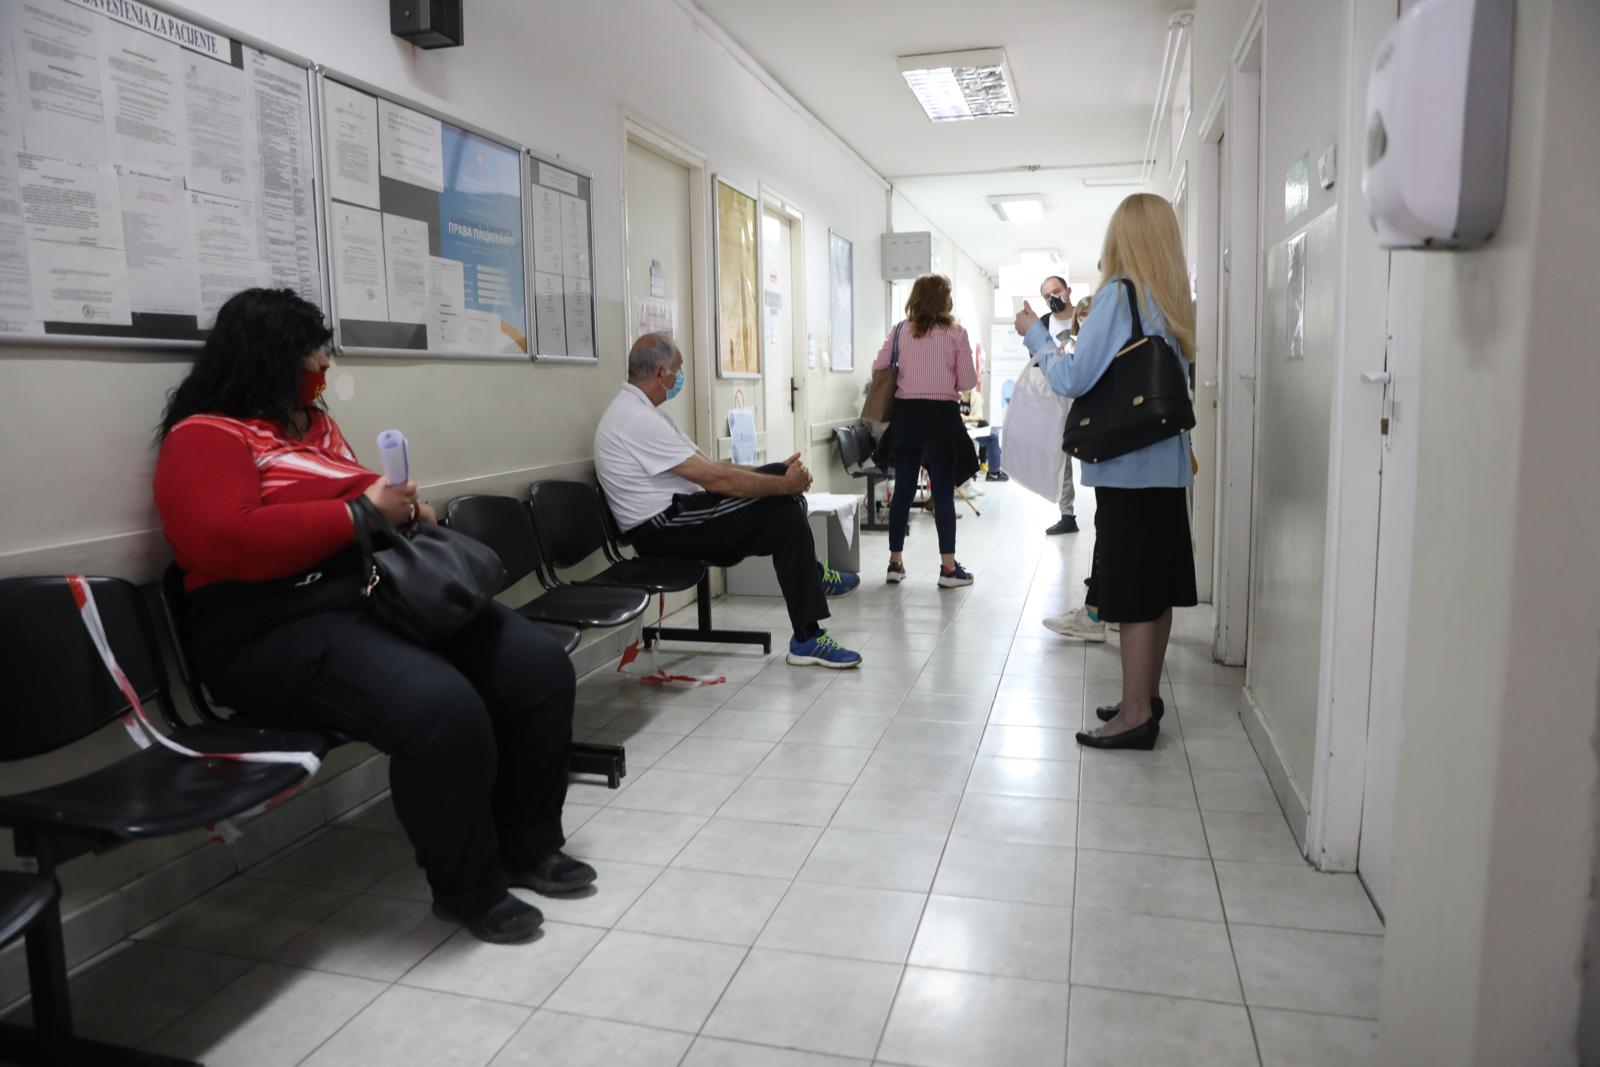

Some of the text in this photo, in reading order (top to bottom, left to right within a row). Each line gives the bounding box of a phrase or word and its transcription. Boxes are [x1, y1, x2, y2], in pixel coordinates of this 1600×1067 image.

[83, 0, 151, 28] VESTENJA
[153, 12, 168, 34] ZA
[169, 19, 218, 54] PACIJENTE
[448, 222, 472, 238] ПРАВА
